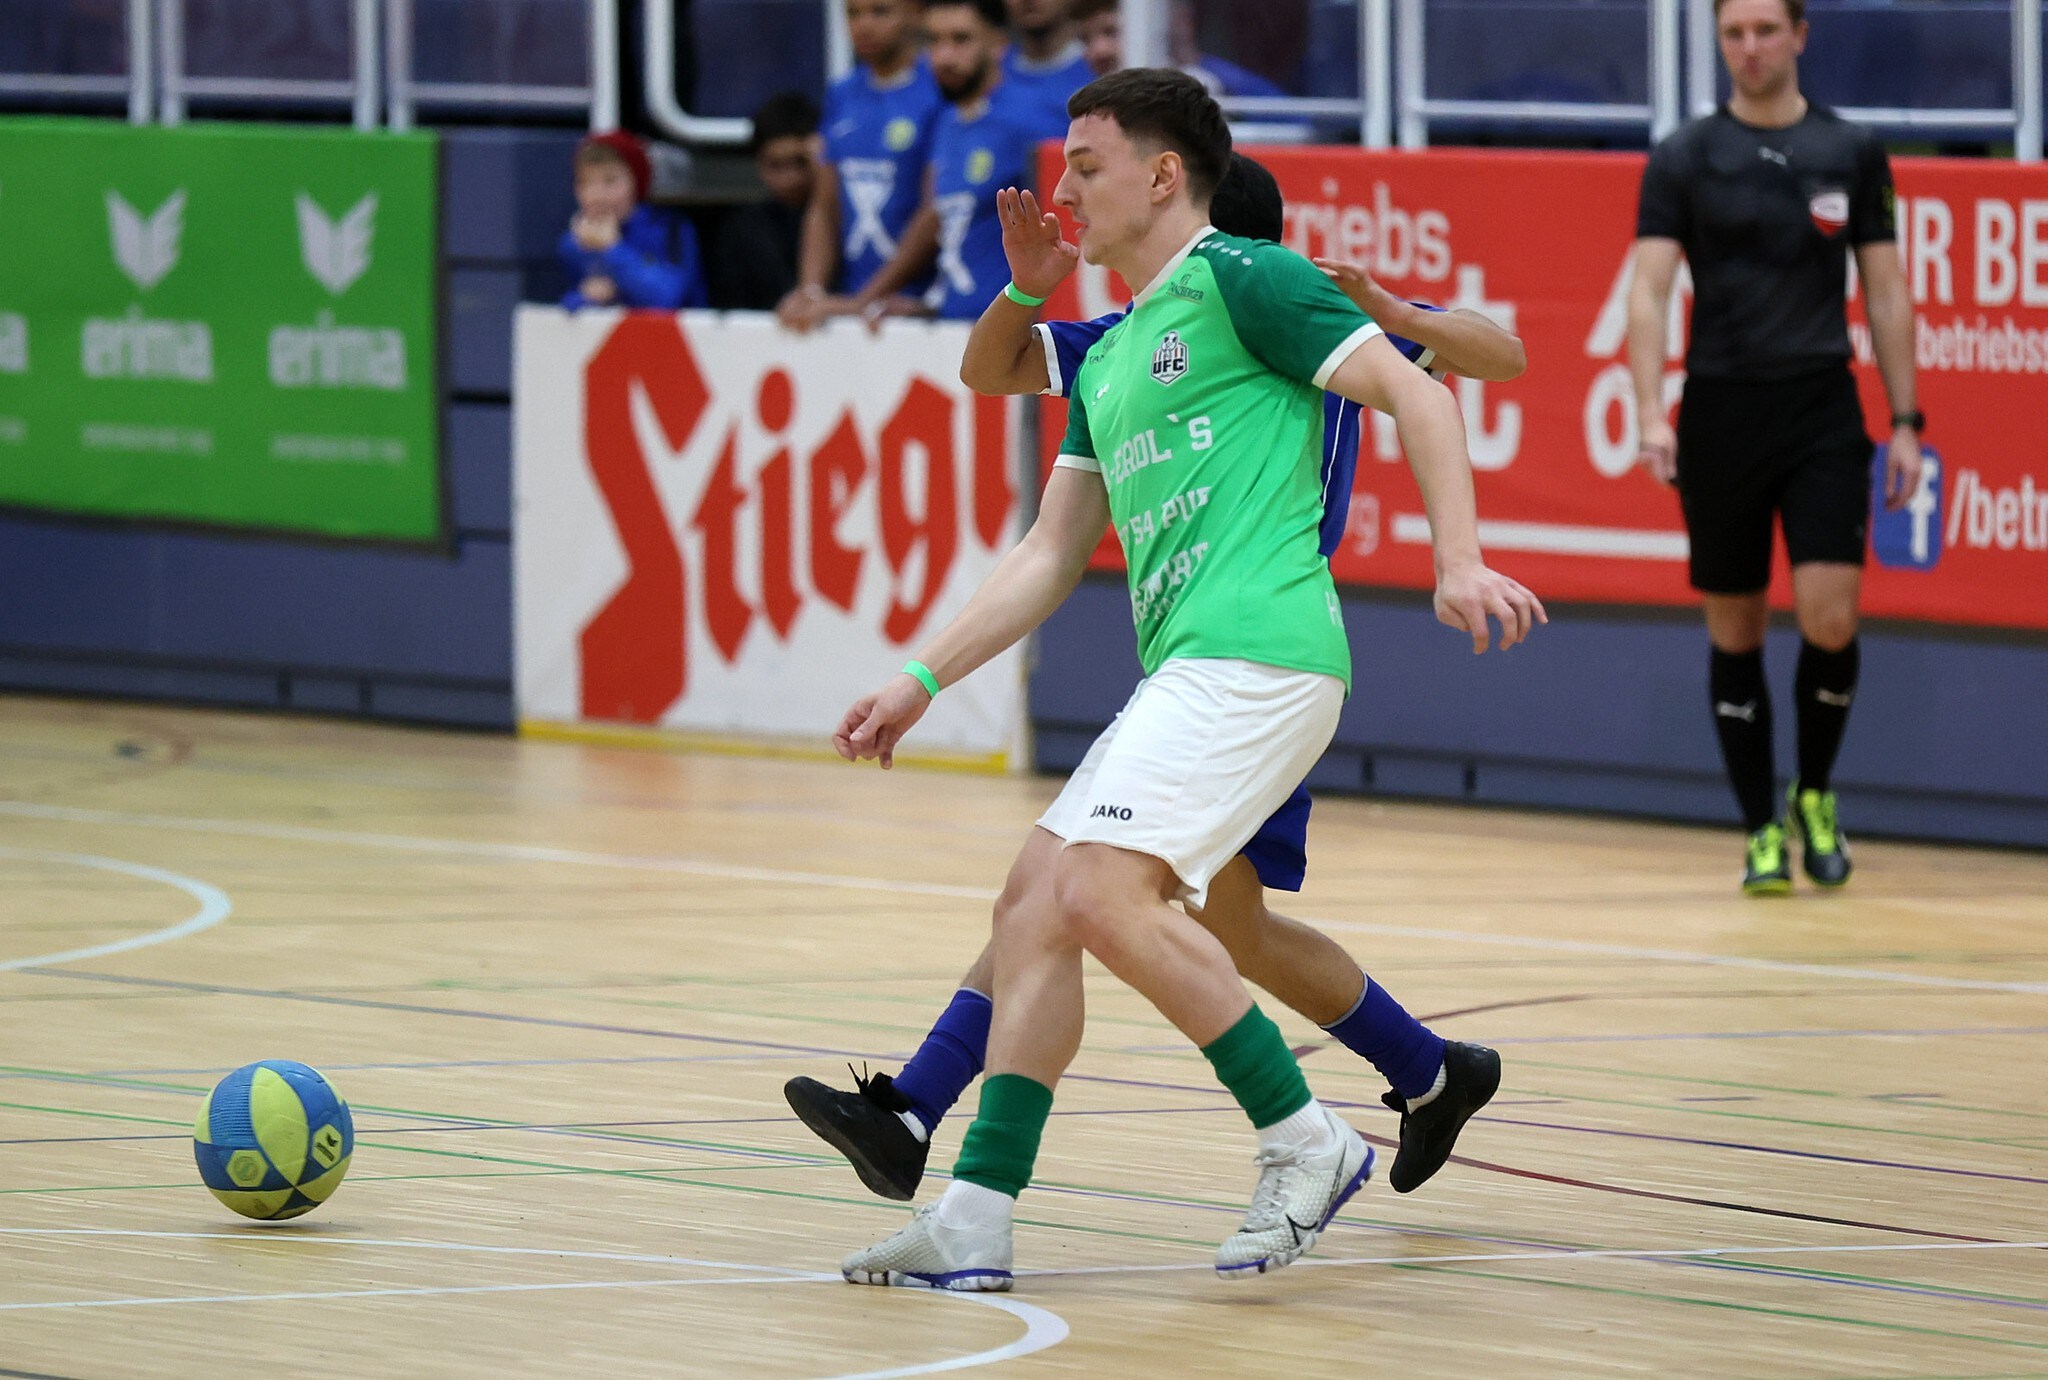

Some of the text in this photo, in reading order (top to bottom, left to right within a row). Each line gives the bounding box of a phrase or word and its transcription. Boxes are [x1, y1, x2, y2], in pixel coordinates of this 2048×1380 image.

[82, 302, 214, 382] erima
[267, 308, 408, 390] erima
[1152, 358, 1185, 375] UFC
[1129, 509, 1156, 546] 54
[1089, 804, 1133, 821] JAKO
